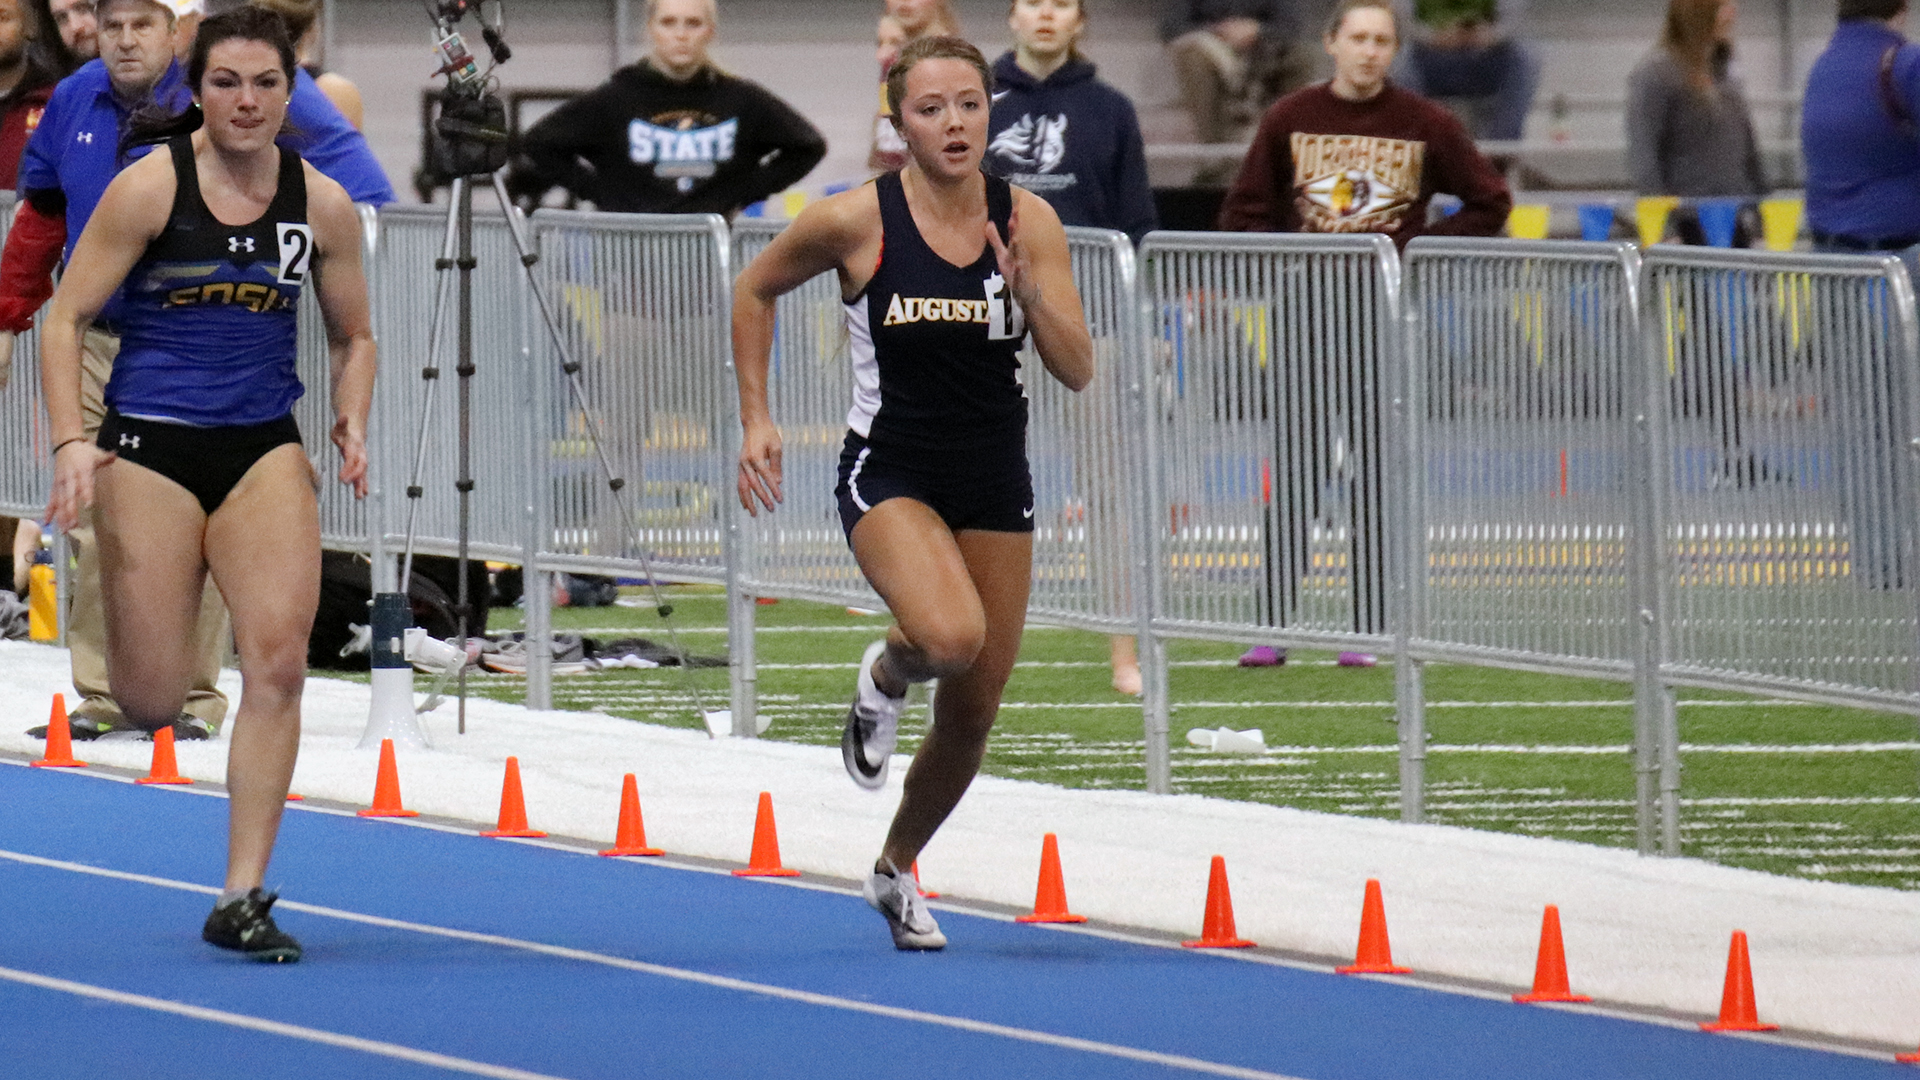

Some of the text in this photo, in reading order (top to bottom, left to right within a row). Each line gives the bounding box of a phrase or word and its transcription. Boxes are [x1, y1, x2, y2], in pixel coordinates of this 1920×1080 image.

[628, 118, 738, 163] STATE
[283, 229, 308, 281] 2
[883, 293, 990, 326] AUGUST
[994, 281, 1013, 335] 1
